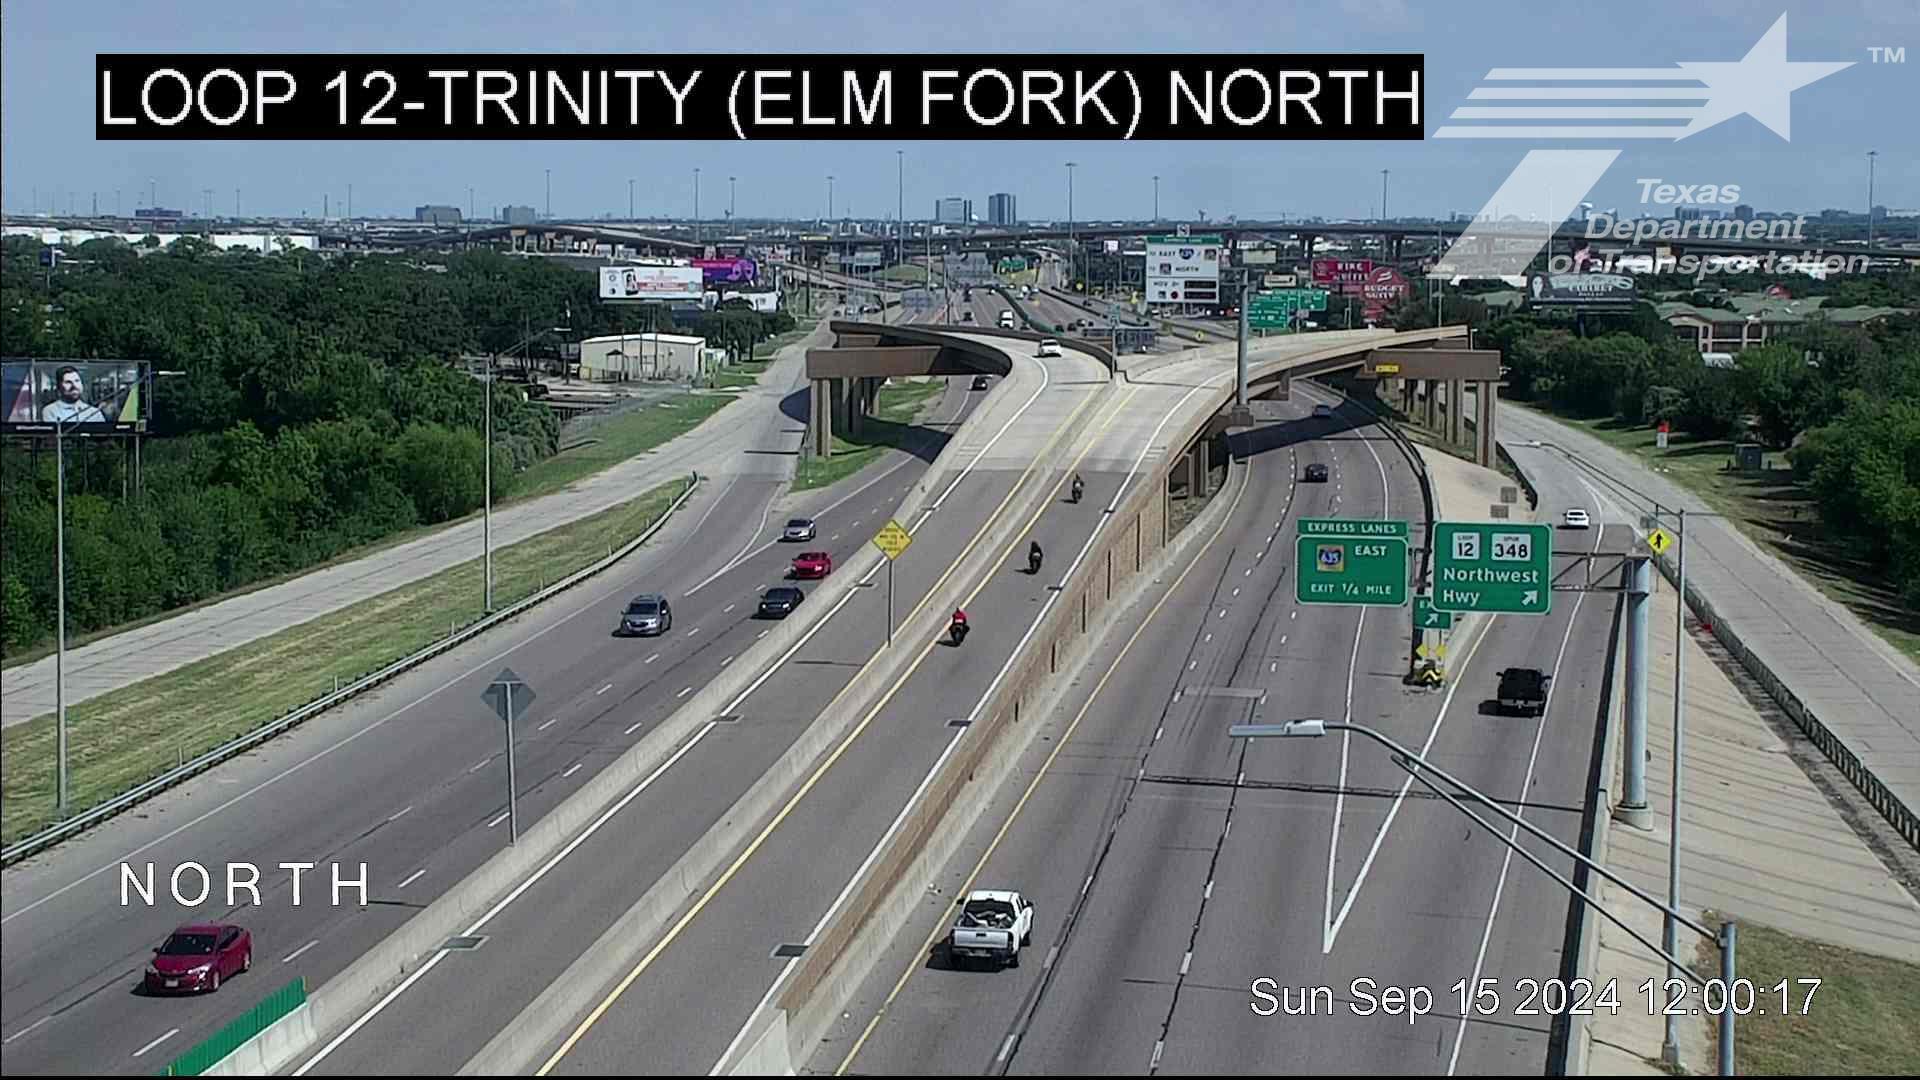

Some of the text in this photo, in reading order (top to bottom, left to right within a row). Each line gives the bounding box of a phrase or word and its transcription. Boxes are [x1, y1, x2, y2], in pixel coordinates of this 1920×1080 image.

[1363, 284, 1405, 292] BUDGET
[1307, 523, 1397, 533] EXPRESS LANES
[1355, 545, 1387, 556] EAST
[1457, 542, 1474, 557] 12
[1494, 543, 1529, 559] 348
[1321, 551, 1339, 563] 635
[1443, 567, 1539, 584] Northwest
[1311, 583, 1392, 596] EXIT 1/4 MILE
[1443, 589, 1480, 607] Hwy
